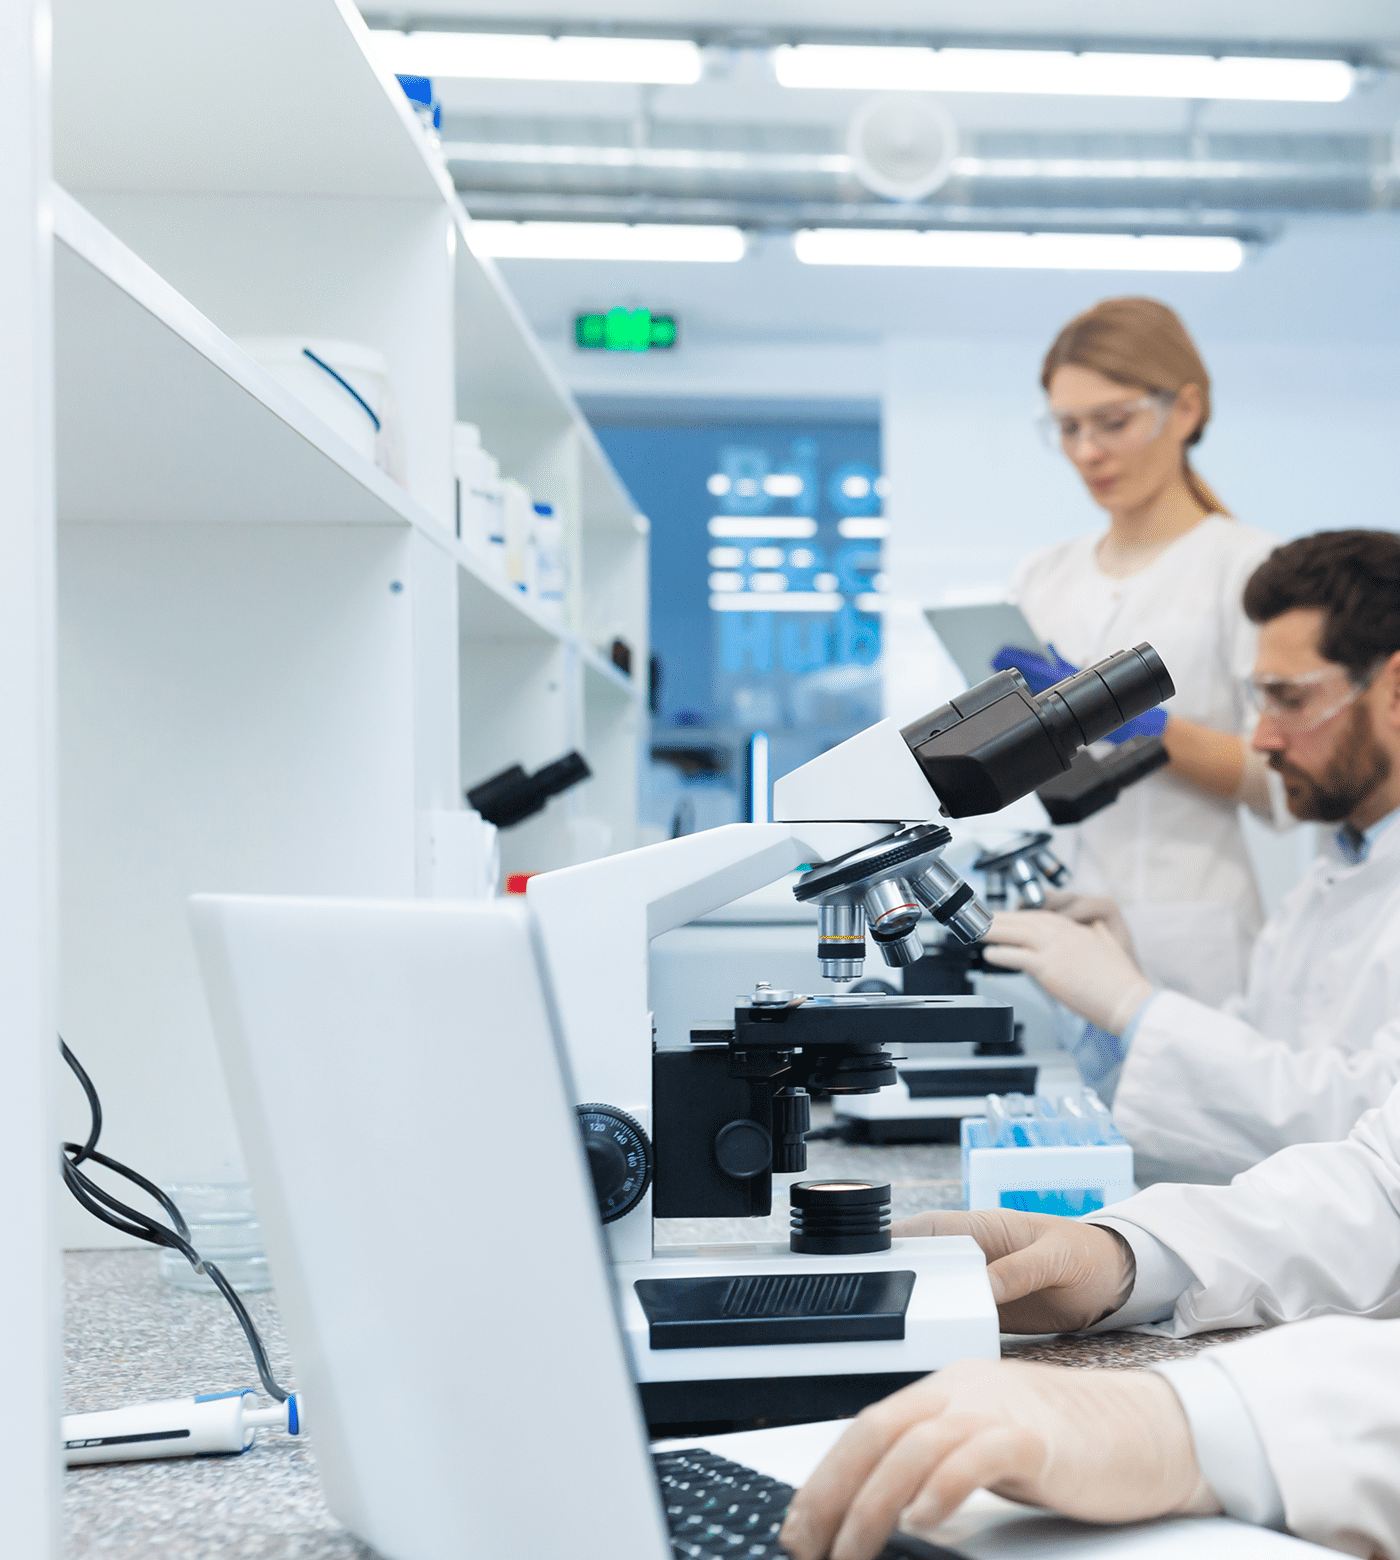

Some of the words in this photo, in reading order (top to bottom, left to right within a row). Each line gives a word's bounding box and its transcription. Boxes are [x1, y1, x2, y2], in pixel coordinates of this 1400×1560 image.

[719, 600, 884, 673] Hub
[589, 1122, 606, 1132] 120
[613, 1130, 628, 1145] 140
[627, 1151, 637, 1168] 160
